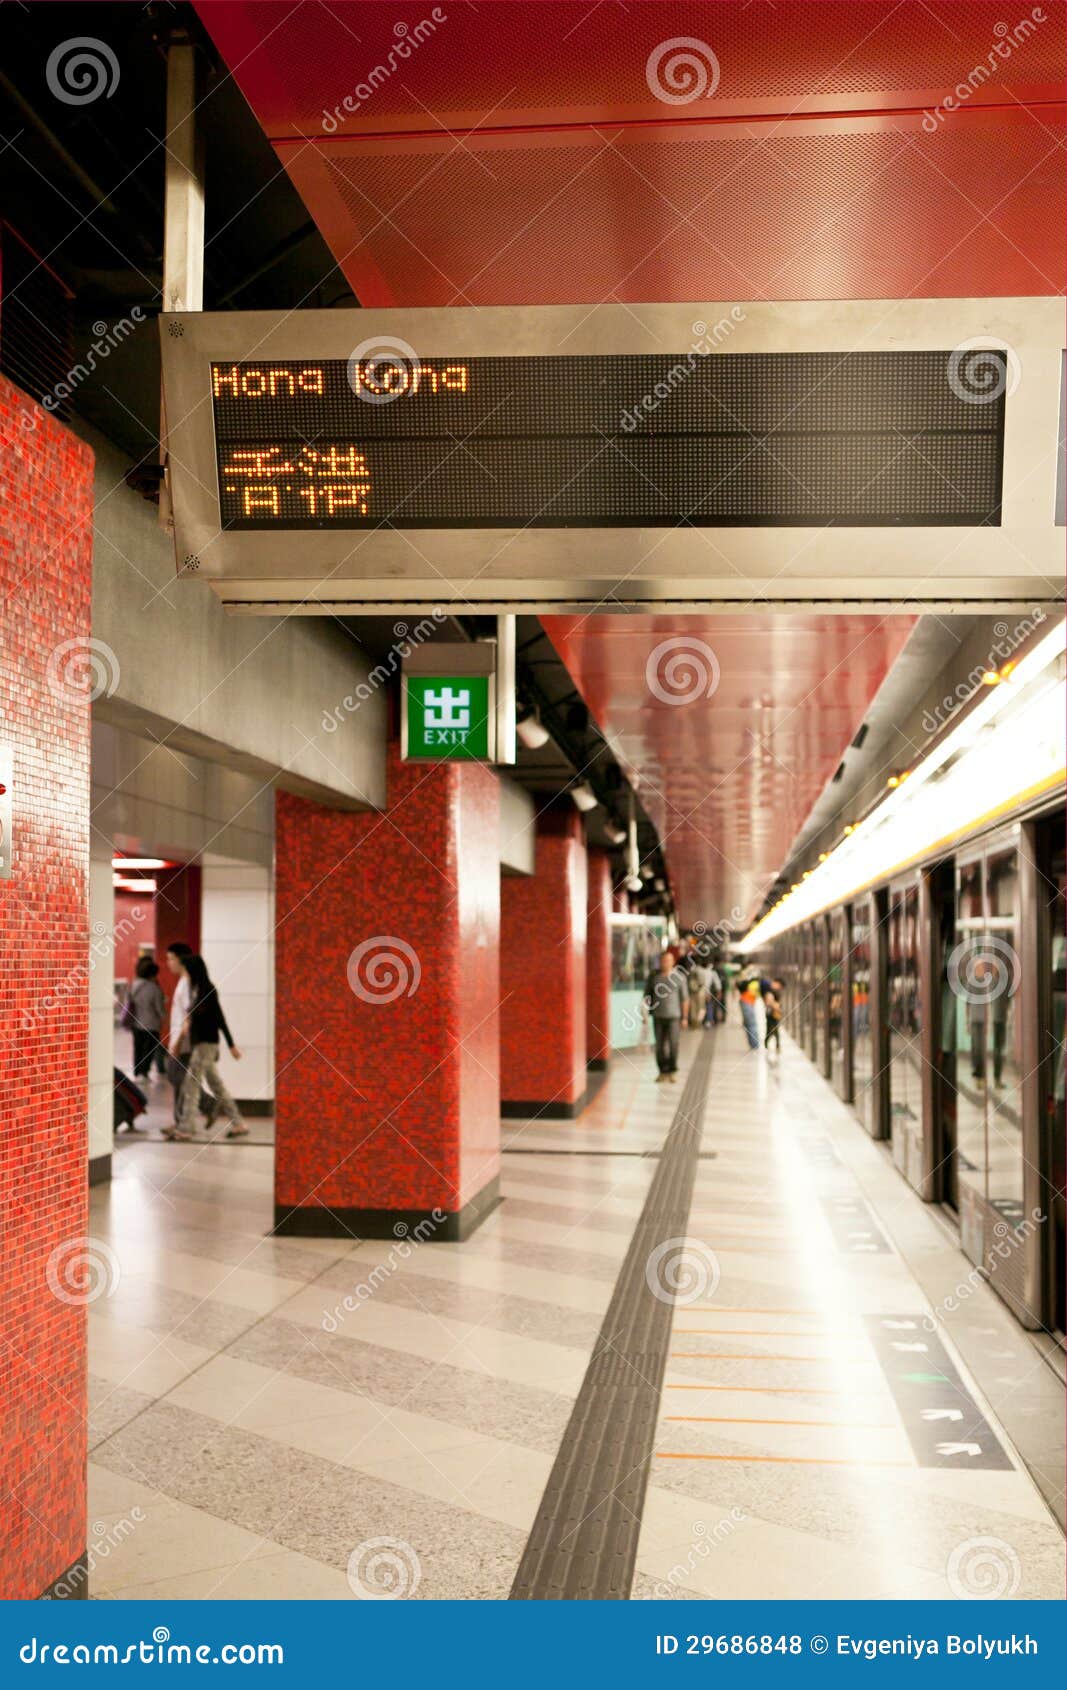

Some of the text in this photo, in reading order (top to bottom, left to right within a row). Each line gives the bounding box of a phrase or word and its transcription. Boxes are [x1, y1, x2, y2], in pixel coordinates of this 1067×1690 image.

[213, 366, 323, 397] Hong
[424, 687, 470, 728] 出
[424, 730, 469, 745] EXIT
